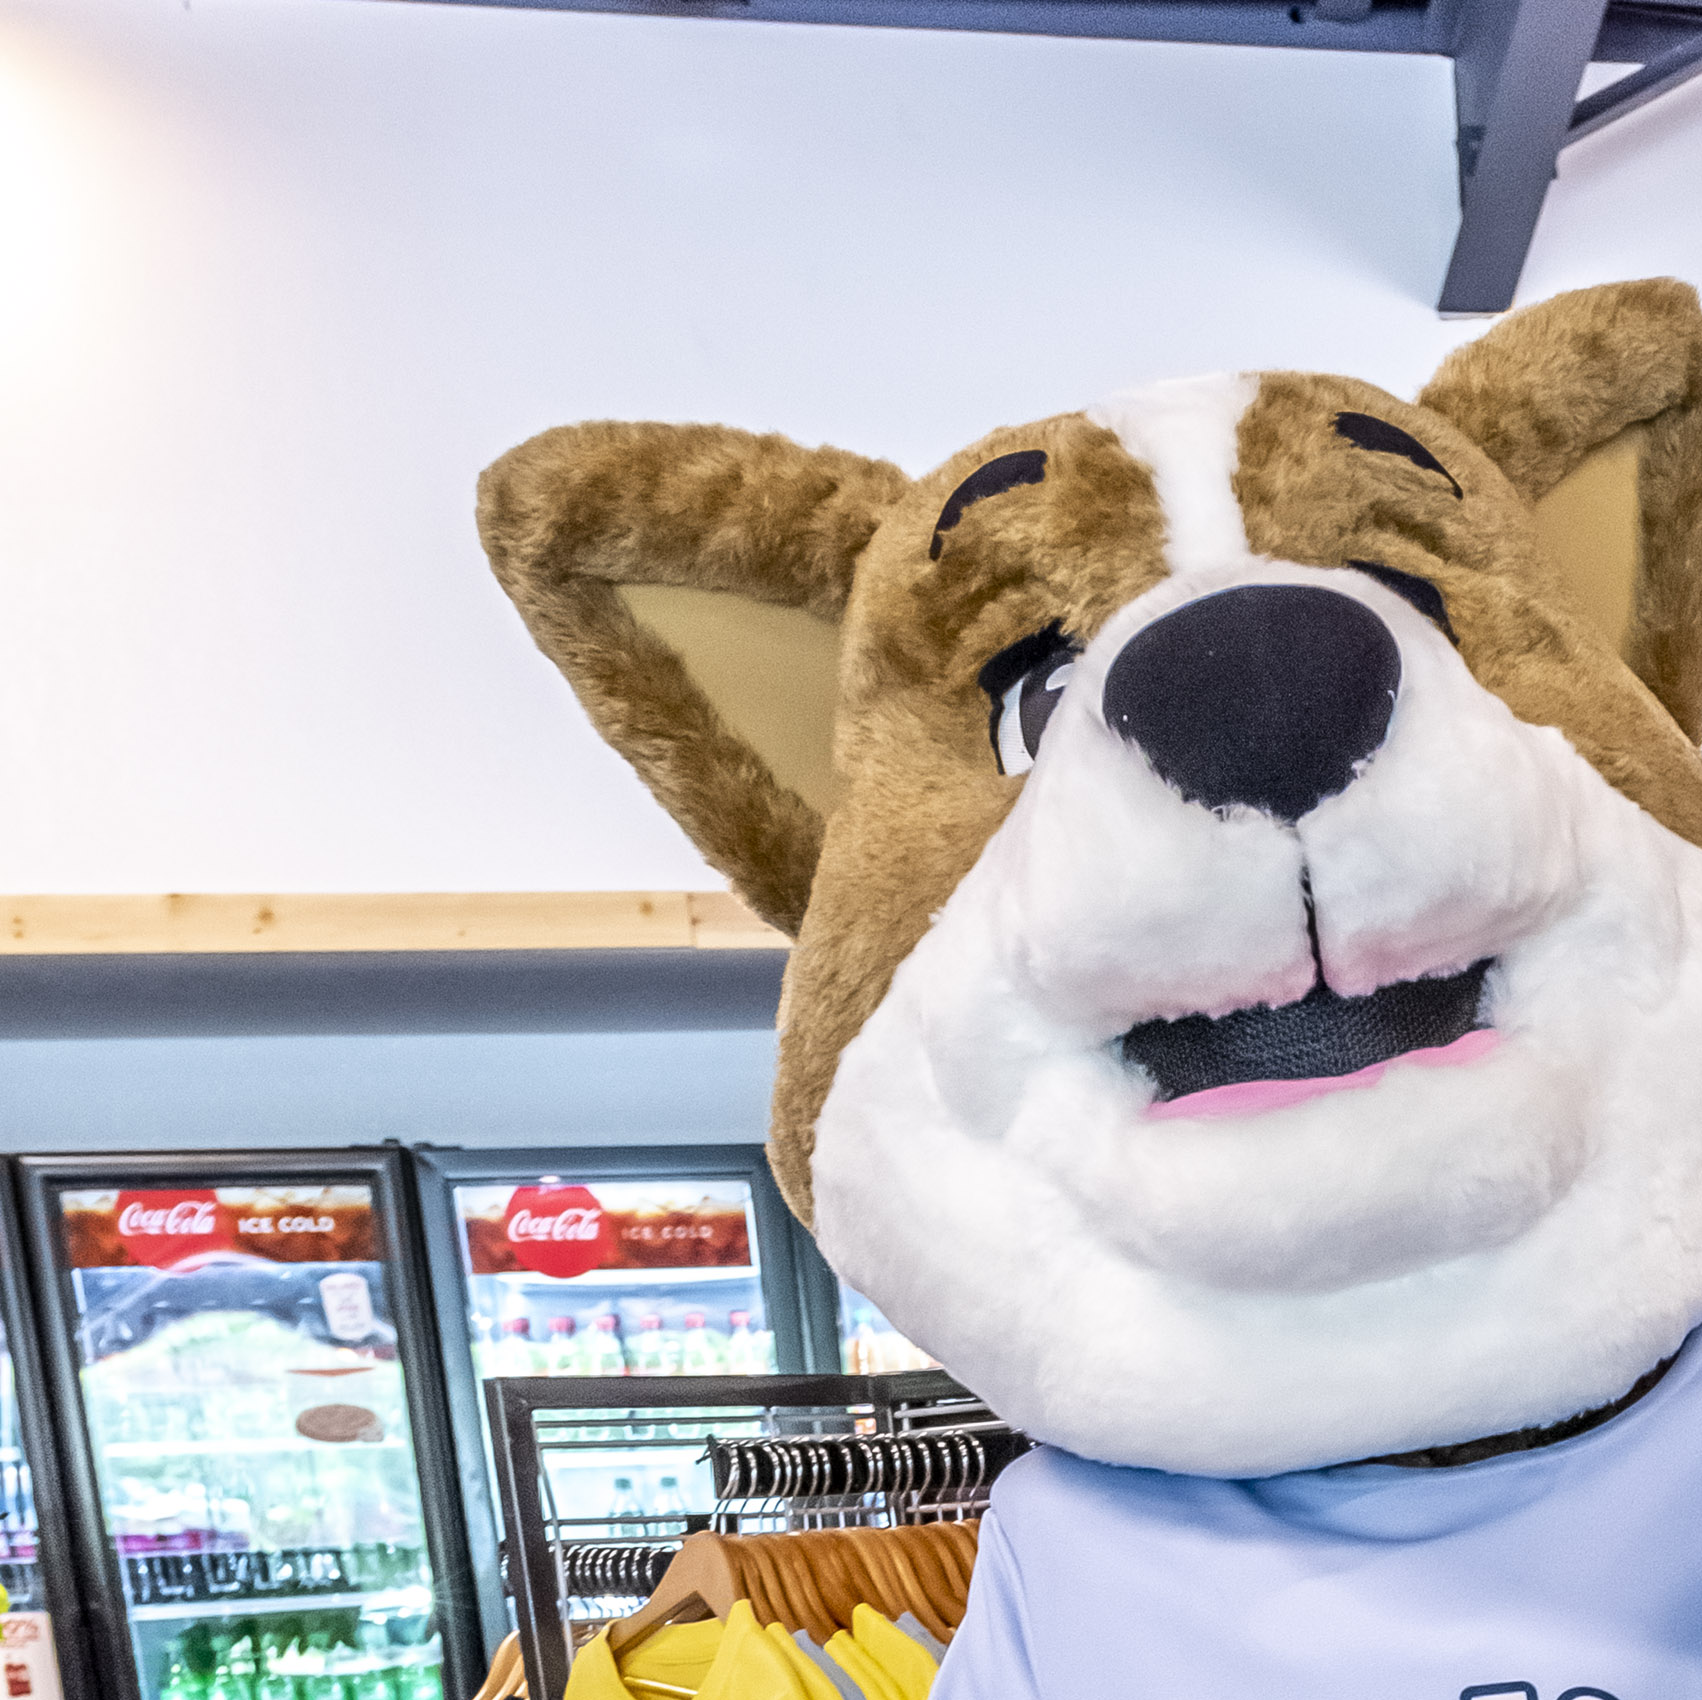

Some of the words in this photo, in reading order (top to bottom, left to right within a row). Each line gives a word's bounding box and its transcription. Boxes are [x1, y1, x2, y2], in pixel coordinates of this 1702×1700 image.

[118, 1201, 217, 1236] Coca-Cola
[238, 1217, 272, 1233] ICE
[278, 1216, 335, 1233] COLD
[507, 1208, 602, 1243] Coca-Cola
[622, 1227, 654, 1241] ICE
[661, 1226, 713, 1240] COLD
